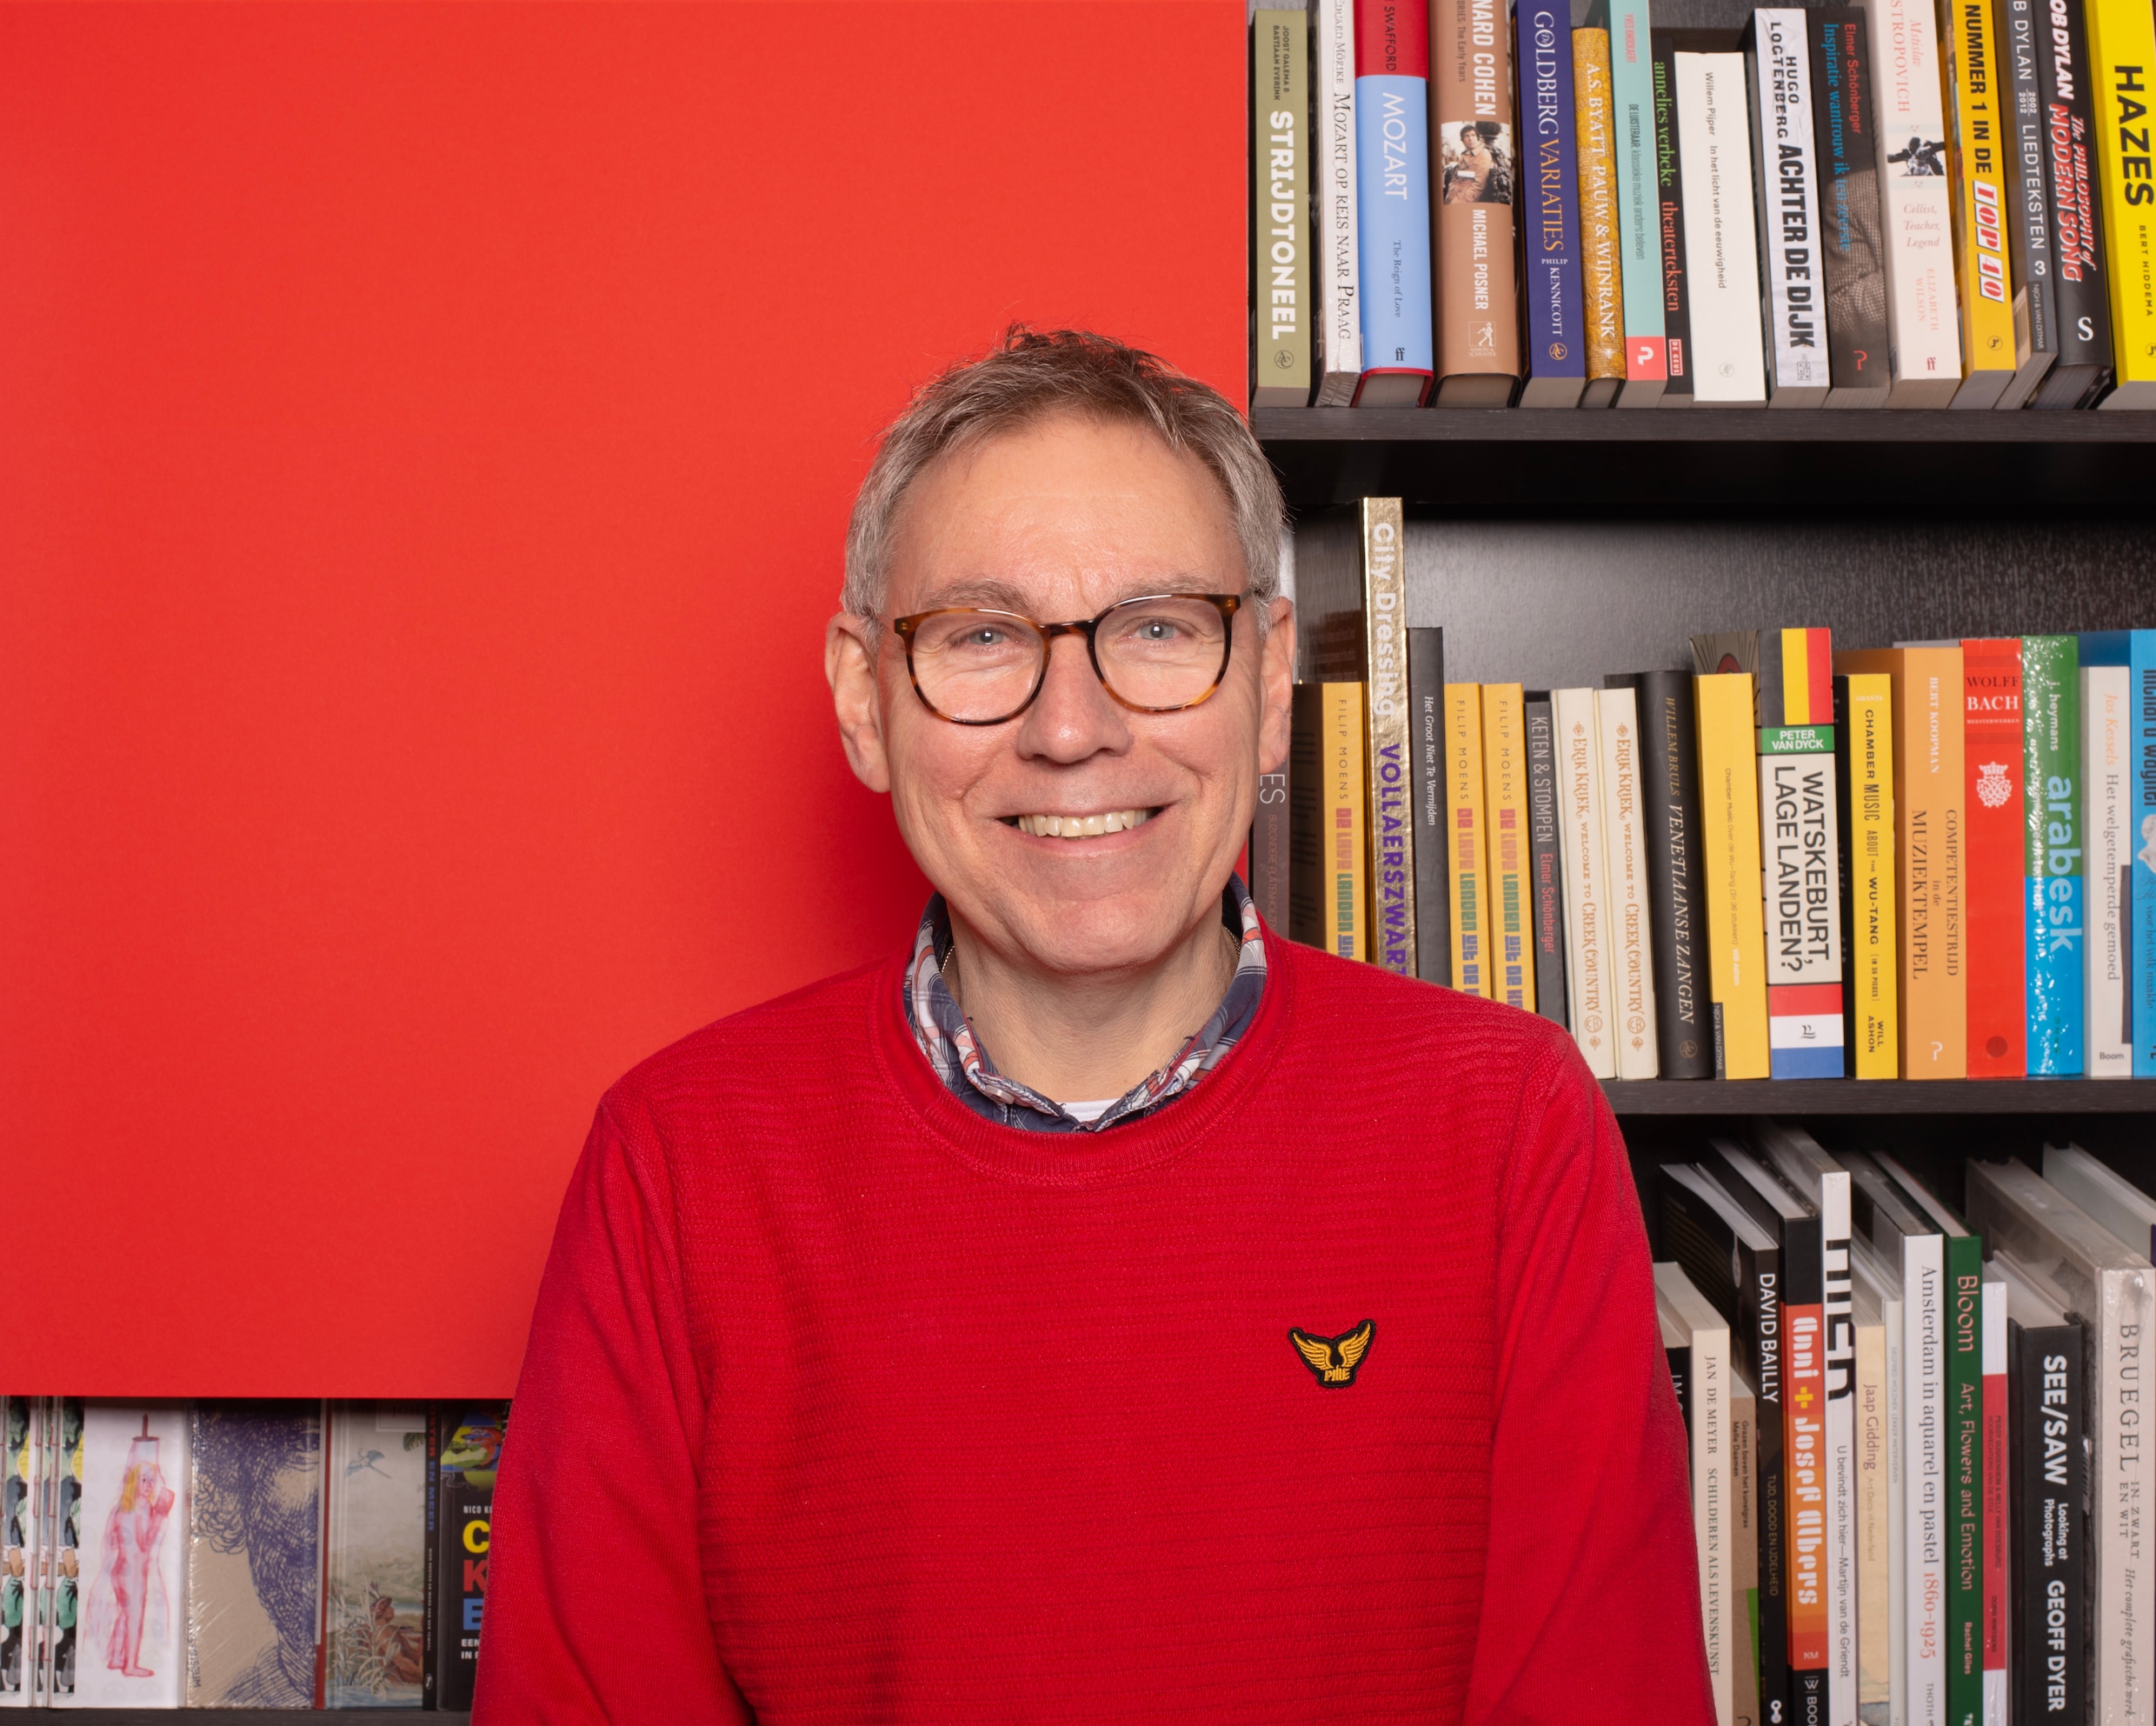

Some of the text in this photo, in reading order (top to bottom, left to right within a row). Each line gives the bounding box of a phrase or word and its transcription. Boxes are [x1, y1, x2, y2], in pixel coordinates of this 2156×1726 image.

[1385, 6, 1398, 72] SWAFFORD
[1473, 53, 1497, 117] COHEN
[1771, 22, 1789, 139] LOGTENBERG
[1787, 57, 1800, 104] HUGO
[1845, 23, 1862, 135] Elmer Schönberger
[1910, 20, 1925, 68] Mstislav
[2015, 20, 2033, 81] DYLAN
[2053, 28, 2075, 101] DYLAN
[1382, 92, 1408, 202] MOZART
[1534, 11, 1564, 251] GOLDBERG VARIATIES
[1822, 23, 1852, 252] Inspiratie wantrouw zeerste
[2019, 92, 2028, 115] 2012
[2029, 92, 2038, 115] 2002
[2114, 65, 2155, 207] HAZES
[1654, 62, 1683, 311] annelies verbeke theaterteksten
[1706, 72, 1727, 290] Willem Pijper eeuwigheid
[1779, 144, 1809, 243] ACHTER
[1965, 4, 2003, 300] NUMMER IN DE TOP 40
[2022, 125, 2046, 250] LIEDTEKSTEN
[2049, 103, 2084, 283] MODERN SONG
[2073, 143, 2095, 253] PHILOSOPHY
[1270, 111, 1296, 340] STRIJDTONEEL
[1335, 93, 1354, 341] MOZART OP REIS NAAR PRAAG
[1587, 63, 1615, 339] A.S. BYATT PAUW WIJNRANK
[1903, 203, 1939, 215] Cellist,
[1903, 221, 1941, 232] Teacher,
[1906, 237, 1940, 250] Legend
[1473, 210, 1489, 310] MICHAEL POSNER
[1550, 268, 1563, 337] KENNICOTT
[1785, 249, 1812, 281] DE
[1916, 278, 1926, 323] WILSON
[1926, 269, 1940, 332] ELIZABETH
[2139, 225, 2154, 317] BERT HIDDEMA
[1787, 287, 1815, 349] DIJK
[1372, 523, 1395, 582] City
[1373, 592, 1399, 717] Dressing
[1966, 676, 2020, 688] WOLFF
[1339, 699, 1348, 800] FILIP MOENS
[1772, 739, 1825, 751] VAN DYCK
[1780, 730, 1816, 741] PETER
[1929, 677, 1940, 774] BERT KOOPMAN
[1966, 696, 2020, 710] BACH
[2050, 694, 2061, 752] heymans
[1531, 717, 1554, 843] KETEN STOMPEN
[1572, 738, 1588, 770] ERIK
[1425, 780, 1438, 827] Vermijden
[1580, 823, 1591, 880] WELCOME
[1864, 710, 1880, 945] CHAMBER MUSIC ABOUT WU-TANG
[2104, 693, 2121, 982] Jos Kessels Het welgetemperde gemoed
[1540, 853, 1556, 954] Elmer Schönberger
[1666, 696, 1695, 1025] WILLEM BRULS VENETIAANSE ZANGEN
[1775, 767, 1804, 973] LAGE LANDEN?
[1802, 771, 1830, 965] WATSKEBURT,
[1912, 810, 1929, 981] MUZIEKTEMPEL
[1946, 810, 1960, 977] COMPETENTIESTRIJD
[2046, 776, 2083, 953] arabesk
[1582, 903, 1597, 950] CREEK
[1585, 950, 1603, 1015] COUNTRY
[2099, 1052, 2125, 1061] Boom
[1760, 1273, 1780, 1403] DAVID BAILLY
[1793, 1316, 1820, 1379] Anni
[1863, 1383, 1880, 1471] Jaap Gidding
[1958, 1276, 1980, 1591] Bloom Art, Flowers and Emotion
[2040, 1355, 2069, 1486] SEE/SAW
[2120, 1324, 2140, 1473] BRUEGEL
[463, 1505, 482, 1515] NICO
[1920, 1266, 1940, 1660] Amsterdam in aquarel en pastel 1860-1925
[1705, 1356, 1720, 1676] JAN DE MEYER SCHILDEREN ALS LEVENSKUNST
[1797, 1509, 1823, 1605] Albers
[2043, 1499, 2055, 1567] Photographs
[2058, 1503, 2069, 1547] Looking
[2119, 1510, 2129, 1539] WIT
[2131, 1507, 2140, 1559] ZWART
[1838, 1457, 1851, 1679] bevindt zich Griendt
[1964, 1622, 1973, 1676] Rachel Giles
[2047, 1580, 2066, 1712] GEOFF DYER
[2120, 1569, 2138, 1718] Het complete grafische werk
[1926, 1683, 1934, 1717] THOTH
